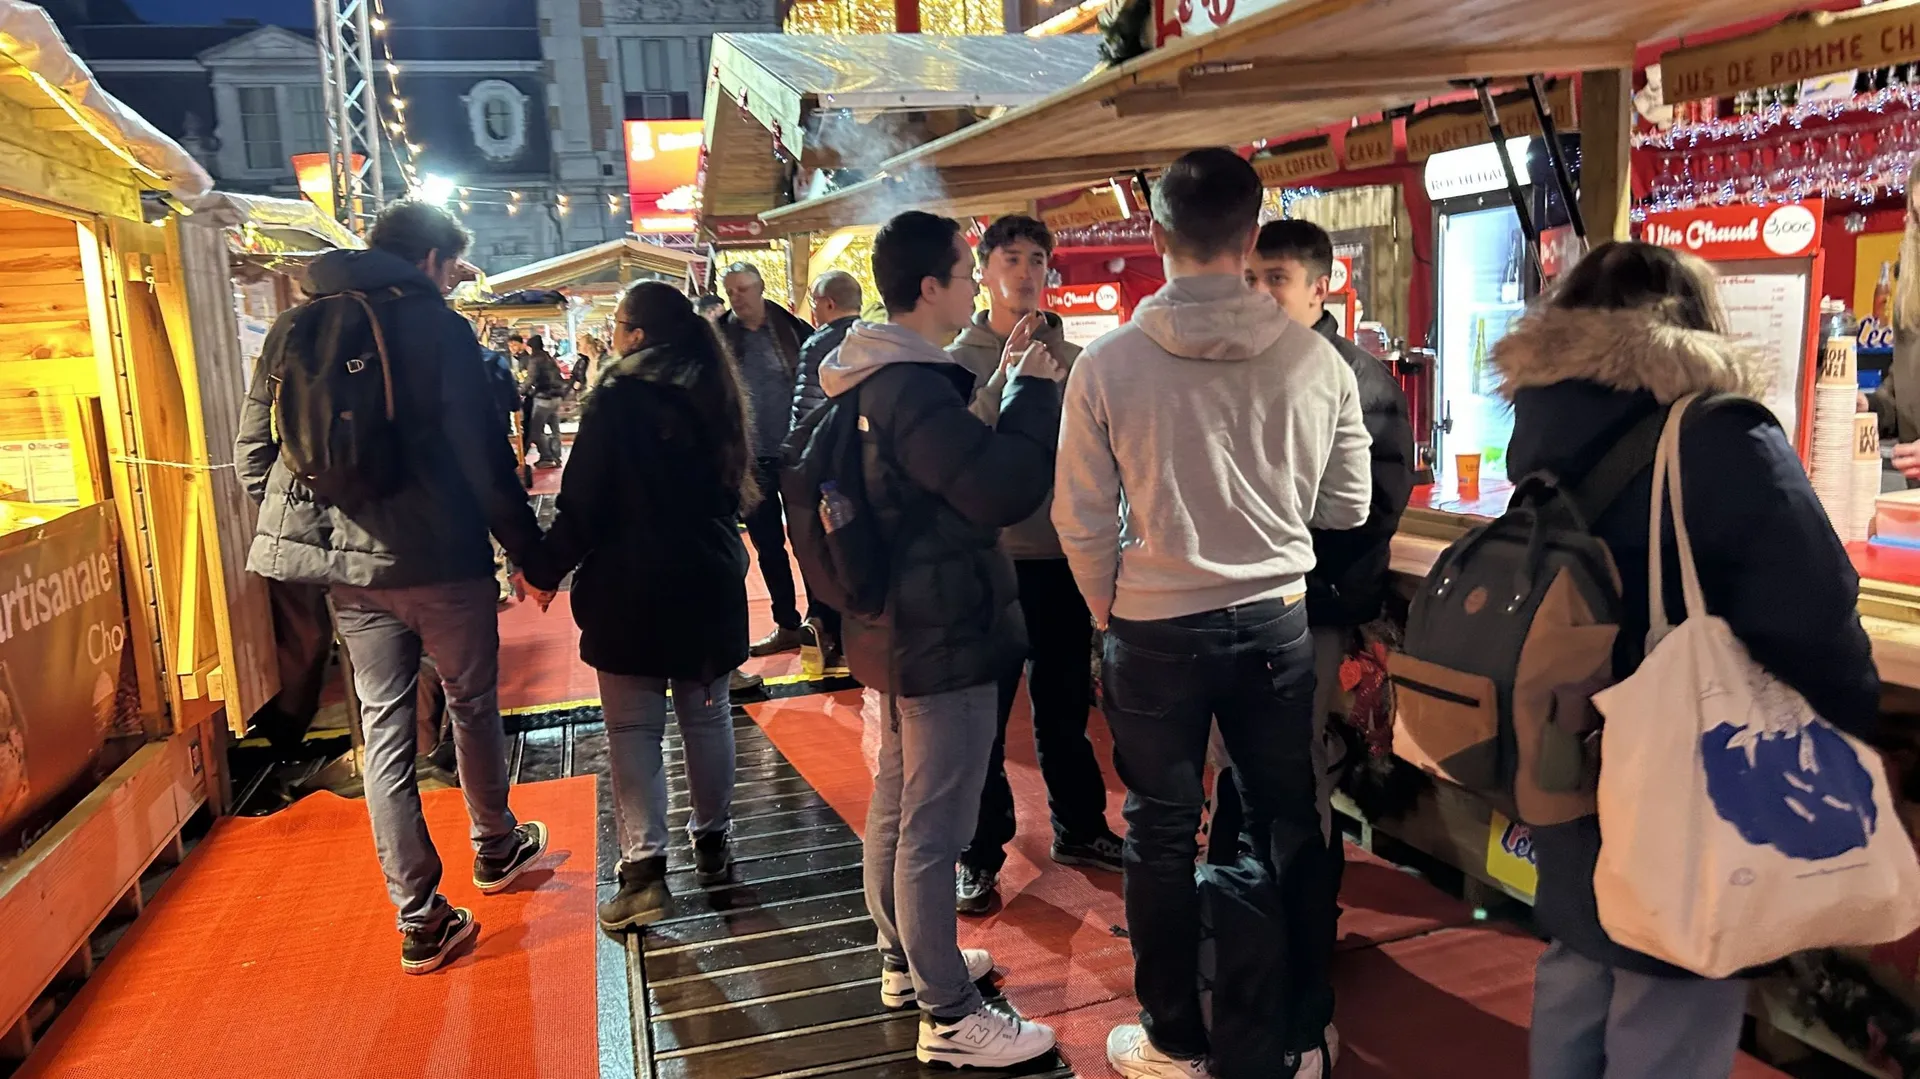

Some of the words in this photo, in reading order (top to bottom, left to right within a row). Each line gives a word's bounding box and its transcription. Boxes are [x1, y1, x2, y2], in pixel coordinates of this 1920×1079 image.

[1673, 71, 1714, 96] JUS
[1728, 59, 1755, 86] DE
[1770, 35, 1863, 77] POMME
[1349, 141, 1384, 161] CAVA
[1410, 122, 1484, 153] AMARETT
[1284, 152, 1329, 176] COFFEE
[1647, 222, 1683, 247] Vin
[1686, 217, 1759, 249] Chaud
[1063, 290, 1095, 308] Chaud
[87, 620, 127, 665] Cho
